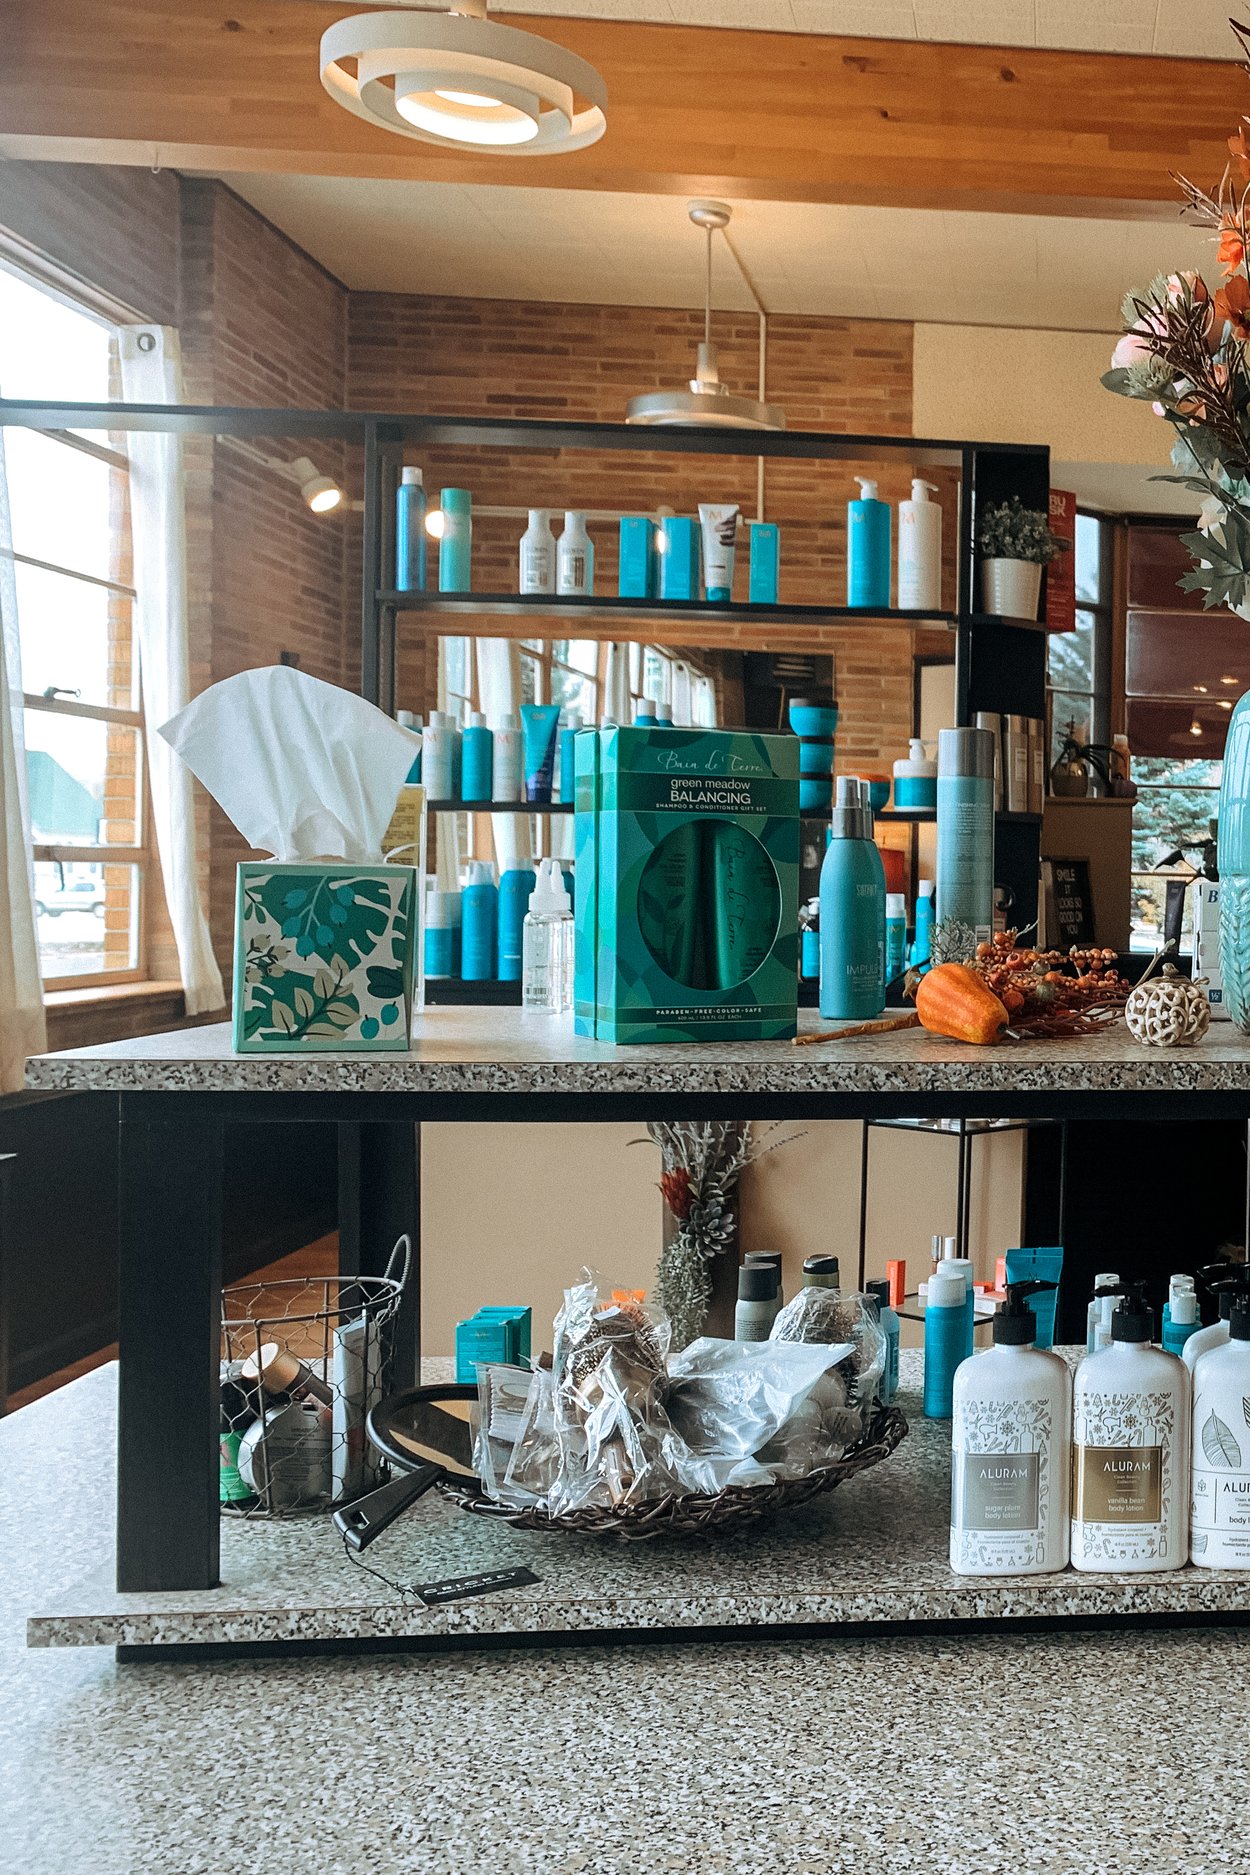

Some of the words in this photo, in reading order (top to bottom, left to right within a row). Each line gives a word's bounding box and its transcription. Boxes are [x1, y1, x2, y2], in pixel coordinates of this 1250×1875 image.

[657, 750, 700, 770] Bain
[704, 749, 720, 771] de
[670, 778, 702, 790] green
[705, 779, 751, 790] meadow
[670, 790, 751, 804] BALANCING
[1103, 1461, 1151, 1472] ALURAM
[979, 1468, 1028, 1479] ALURAM
[984, 1505, 1003, 1513] sugar
[1004, 1504, 1021, 1512] plum
[1108, 1504, 1125, 1513] body
[1126, 1504, 1144, 1512] lotion
[984, 1512, 1001, 1520] body
[1002, 1511, 1021, 1519] lotion
[1229, 1515, 1247, 1525] body
[424, 1571, 517, 1596] CRICKET
